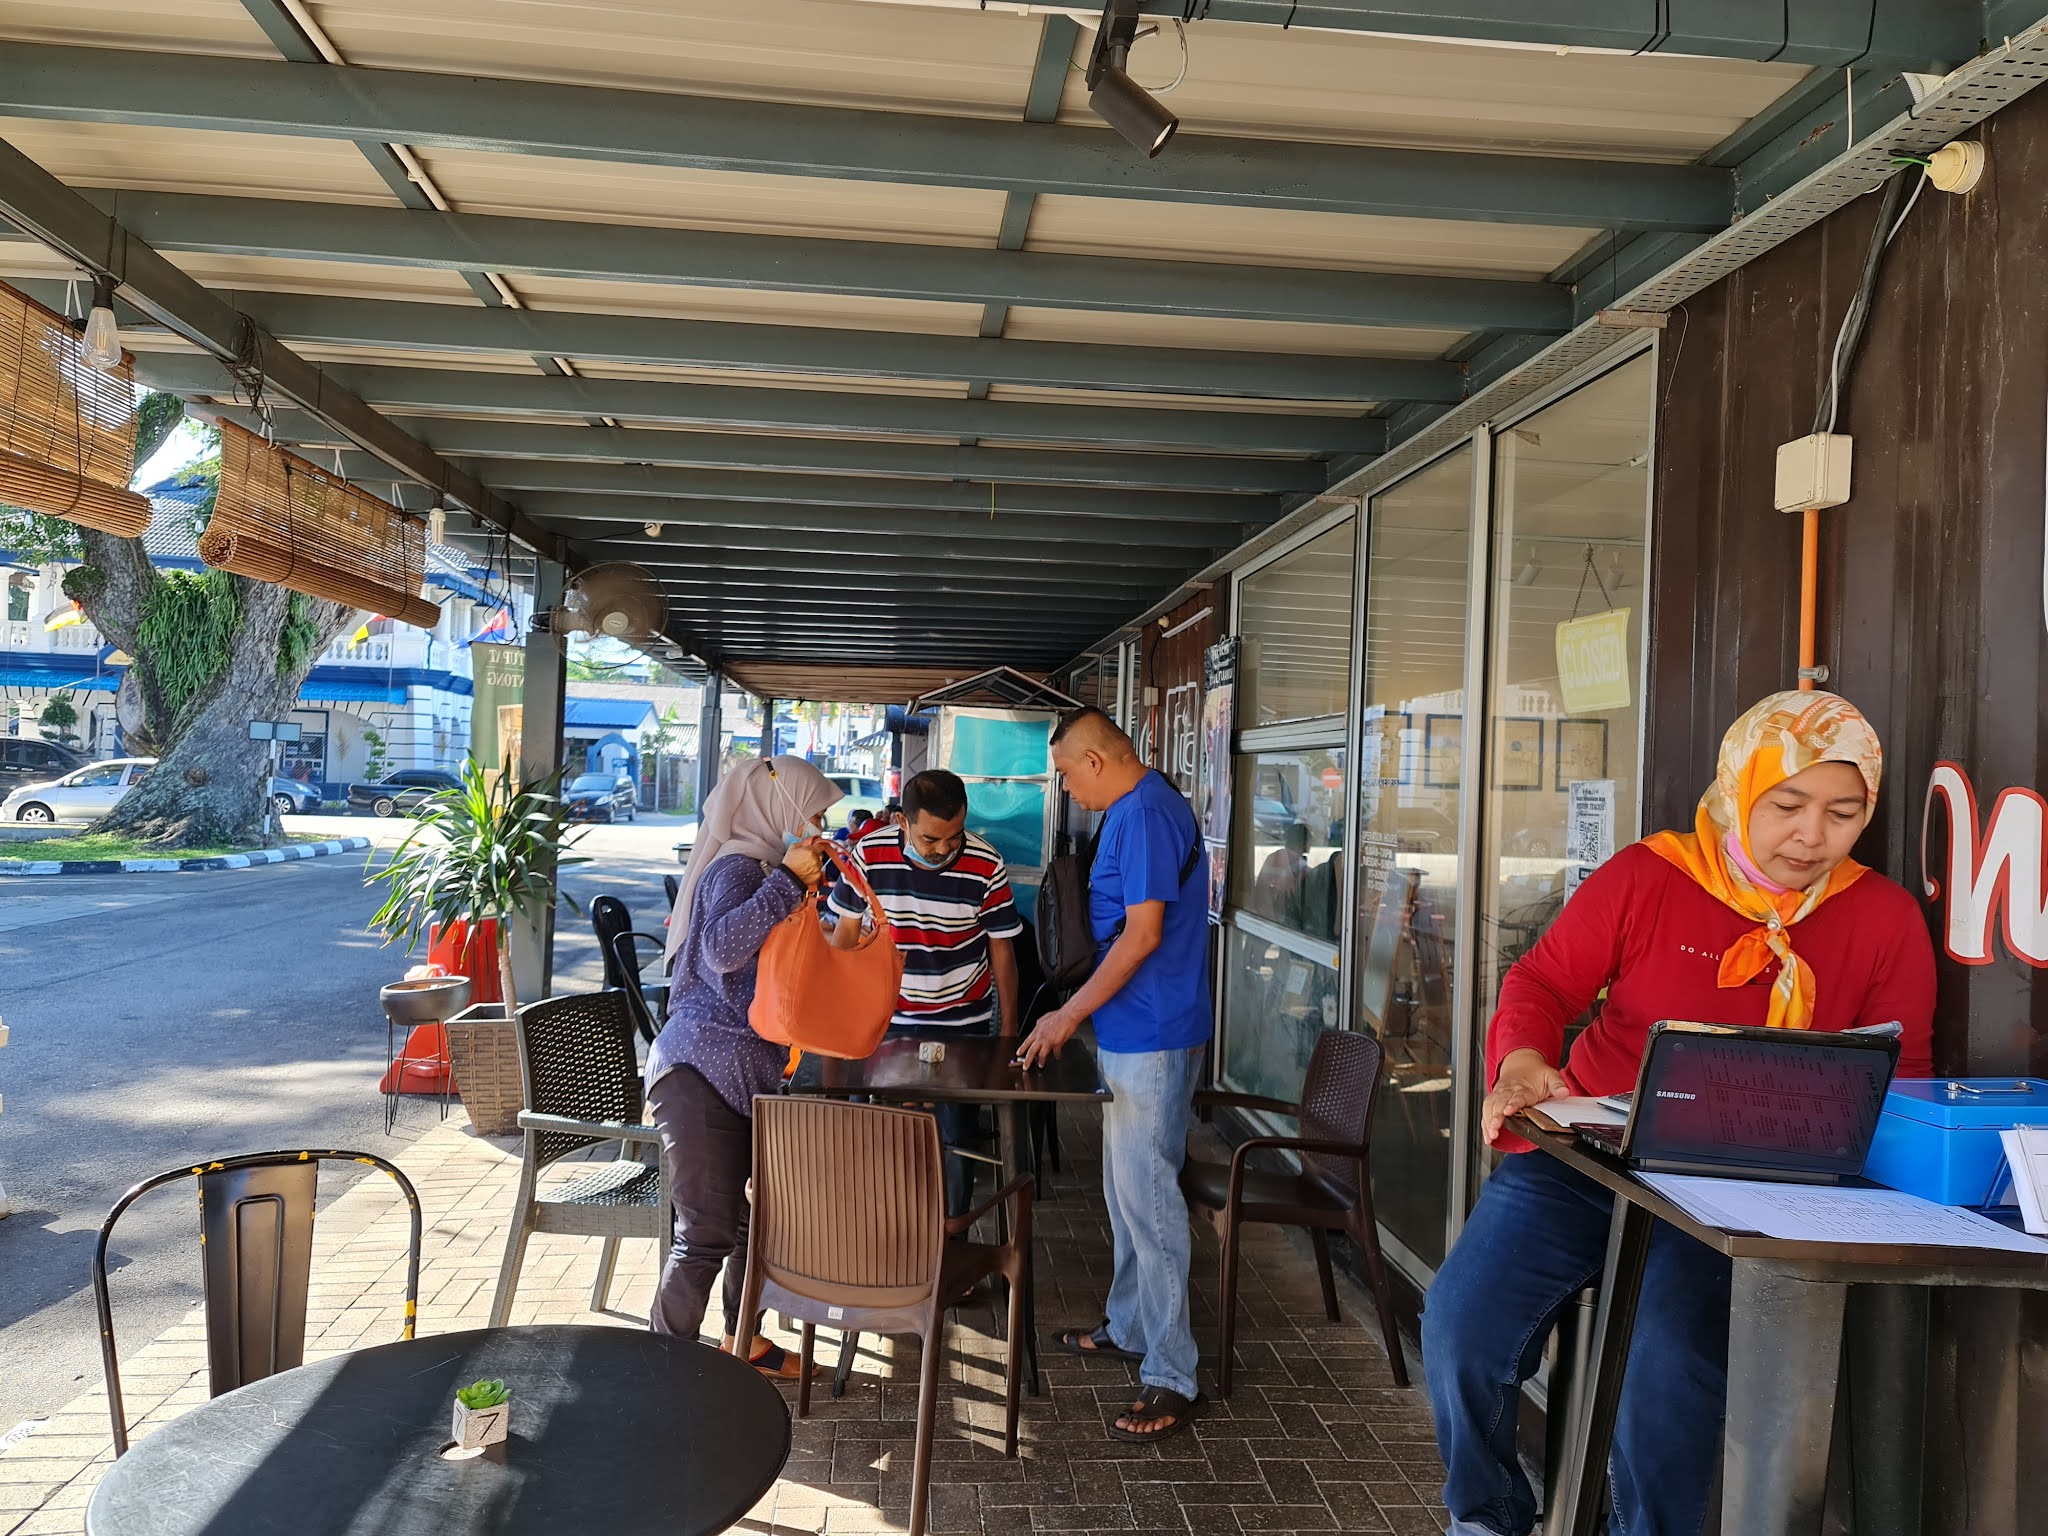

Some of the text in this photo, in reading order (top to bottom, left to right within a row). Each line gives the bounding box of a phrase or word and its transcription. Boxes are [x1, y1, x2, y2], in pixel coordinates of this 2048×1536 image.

[1562, 633, 1622, 689] CLOSED
[1680, 944, 1720, 961] DO ALL
[1656, 1090, 1696, 1100] SAMSUNG
[477, 1412, 500, 1441] 7
